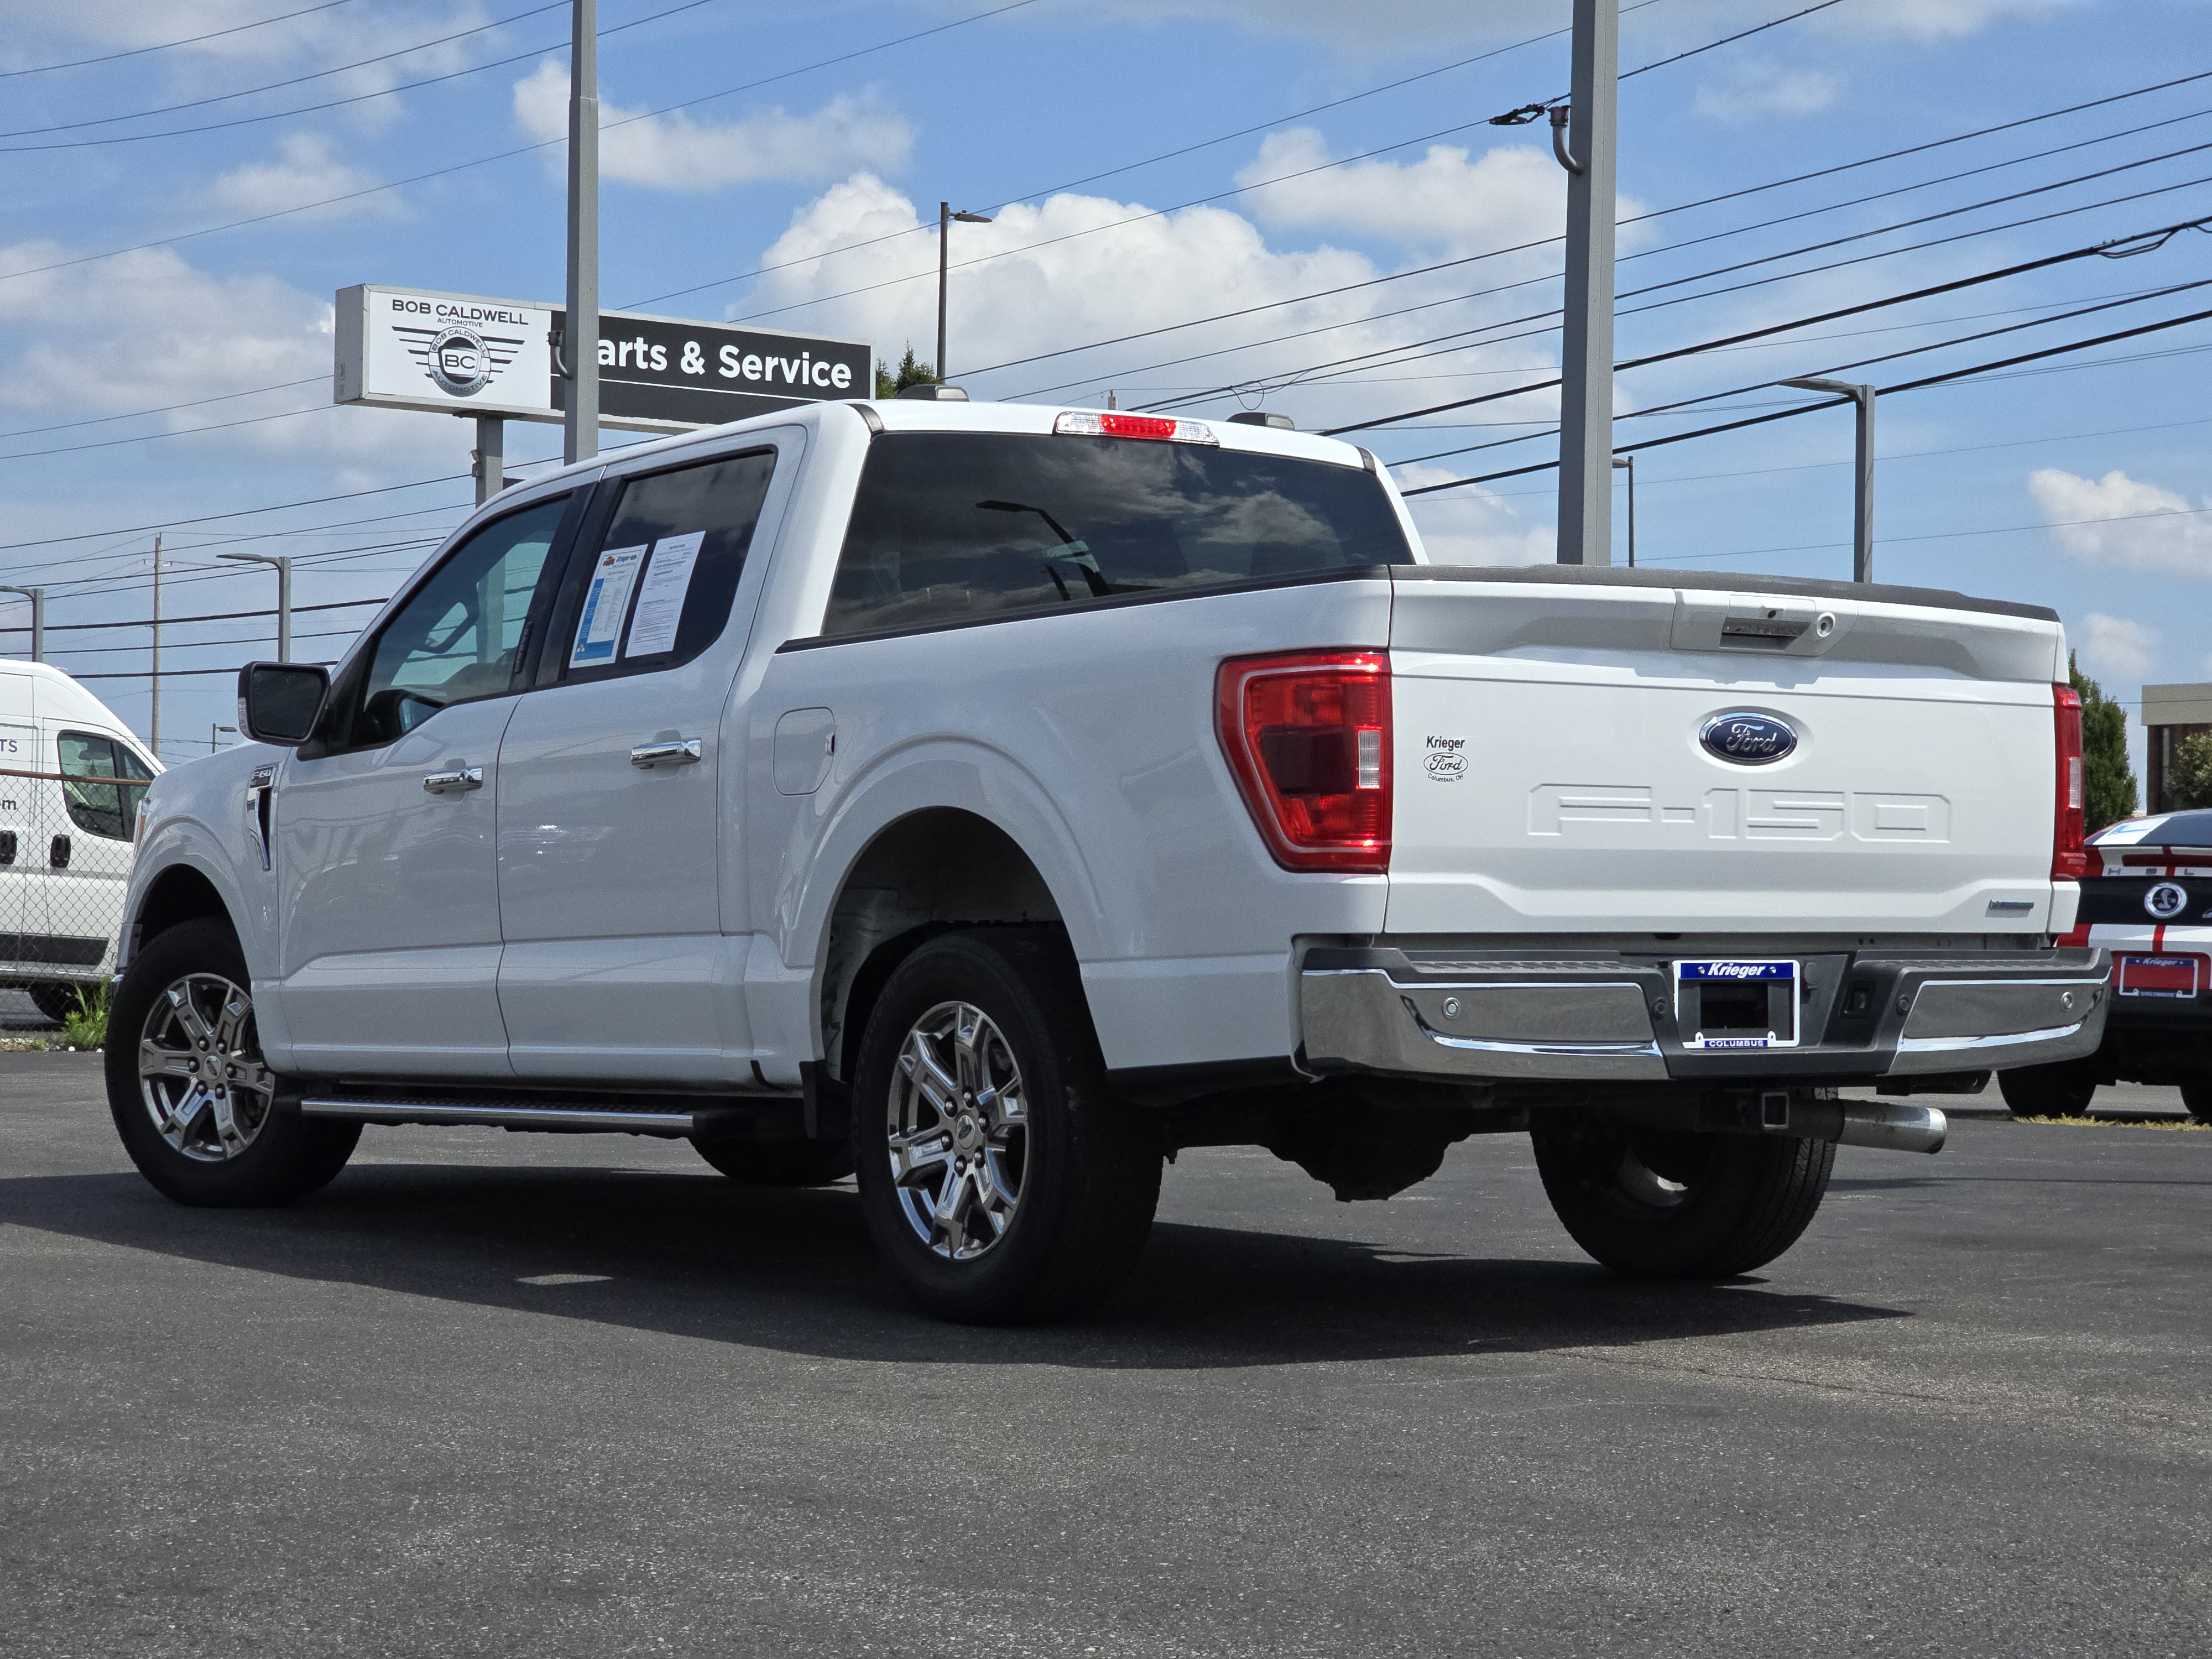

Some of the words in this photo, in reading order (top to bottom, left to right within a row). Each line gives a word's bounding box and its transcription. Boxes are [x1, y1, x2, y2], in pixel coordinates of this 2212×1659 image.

[392, 299, 431, 314] BOB
[436, 304, 529, 325] CALDWELL
[437, 317, 483, 328] AUTOMOTIVE
[431, 333, 447, 351] BOB
[448, 329, 487, 356] CALDWELL
[445, 354, 476, 369] BC
[598, 337, 667, 371] arts
[680, 341, 706, 375] &
[718, 345, 852, 389] Service
[432, 369, 487, 393] AUTOMOTIVE
[1426, 735, 1465, 752] Krieger
[1726, 723, 1777, 753] Ford
[1430, 754, 1463, 771] Ford
[1427, 773, 1455, 782] Columbus,
[1527, 782, 1952, 843] F-150
[1708, 963, 1766, 978] Krieger
[2142, 958, 2178, 967] Krieger
